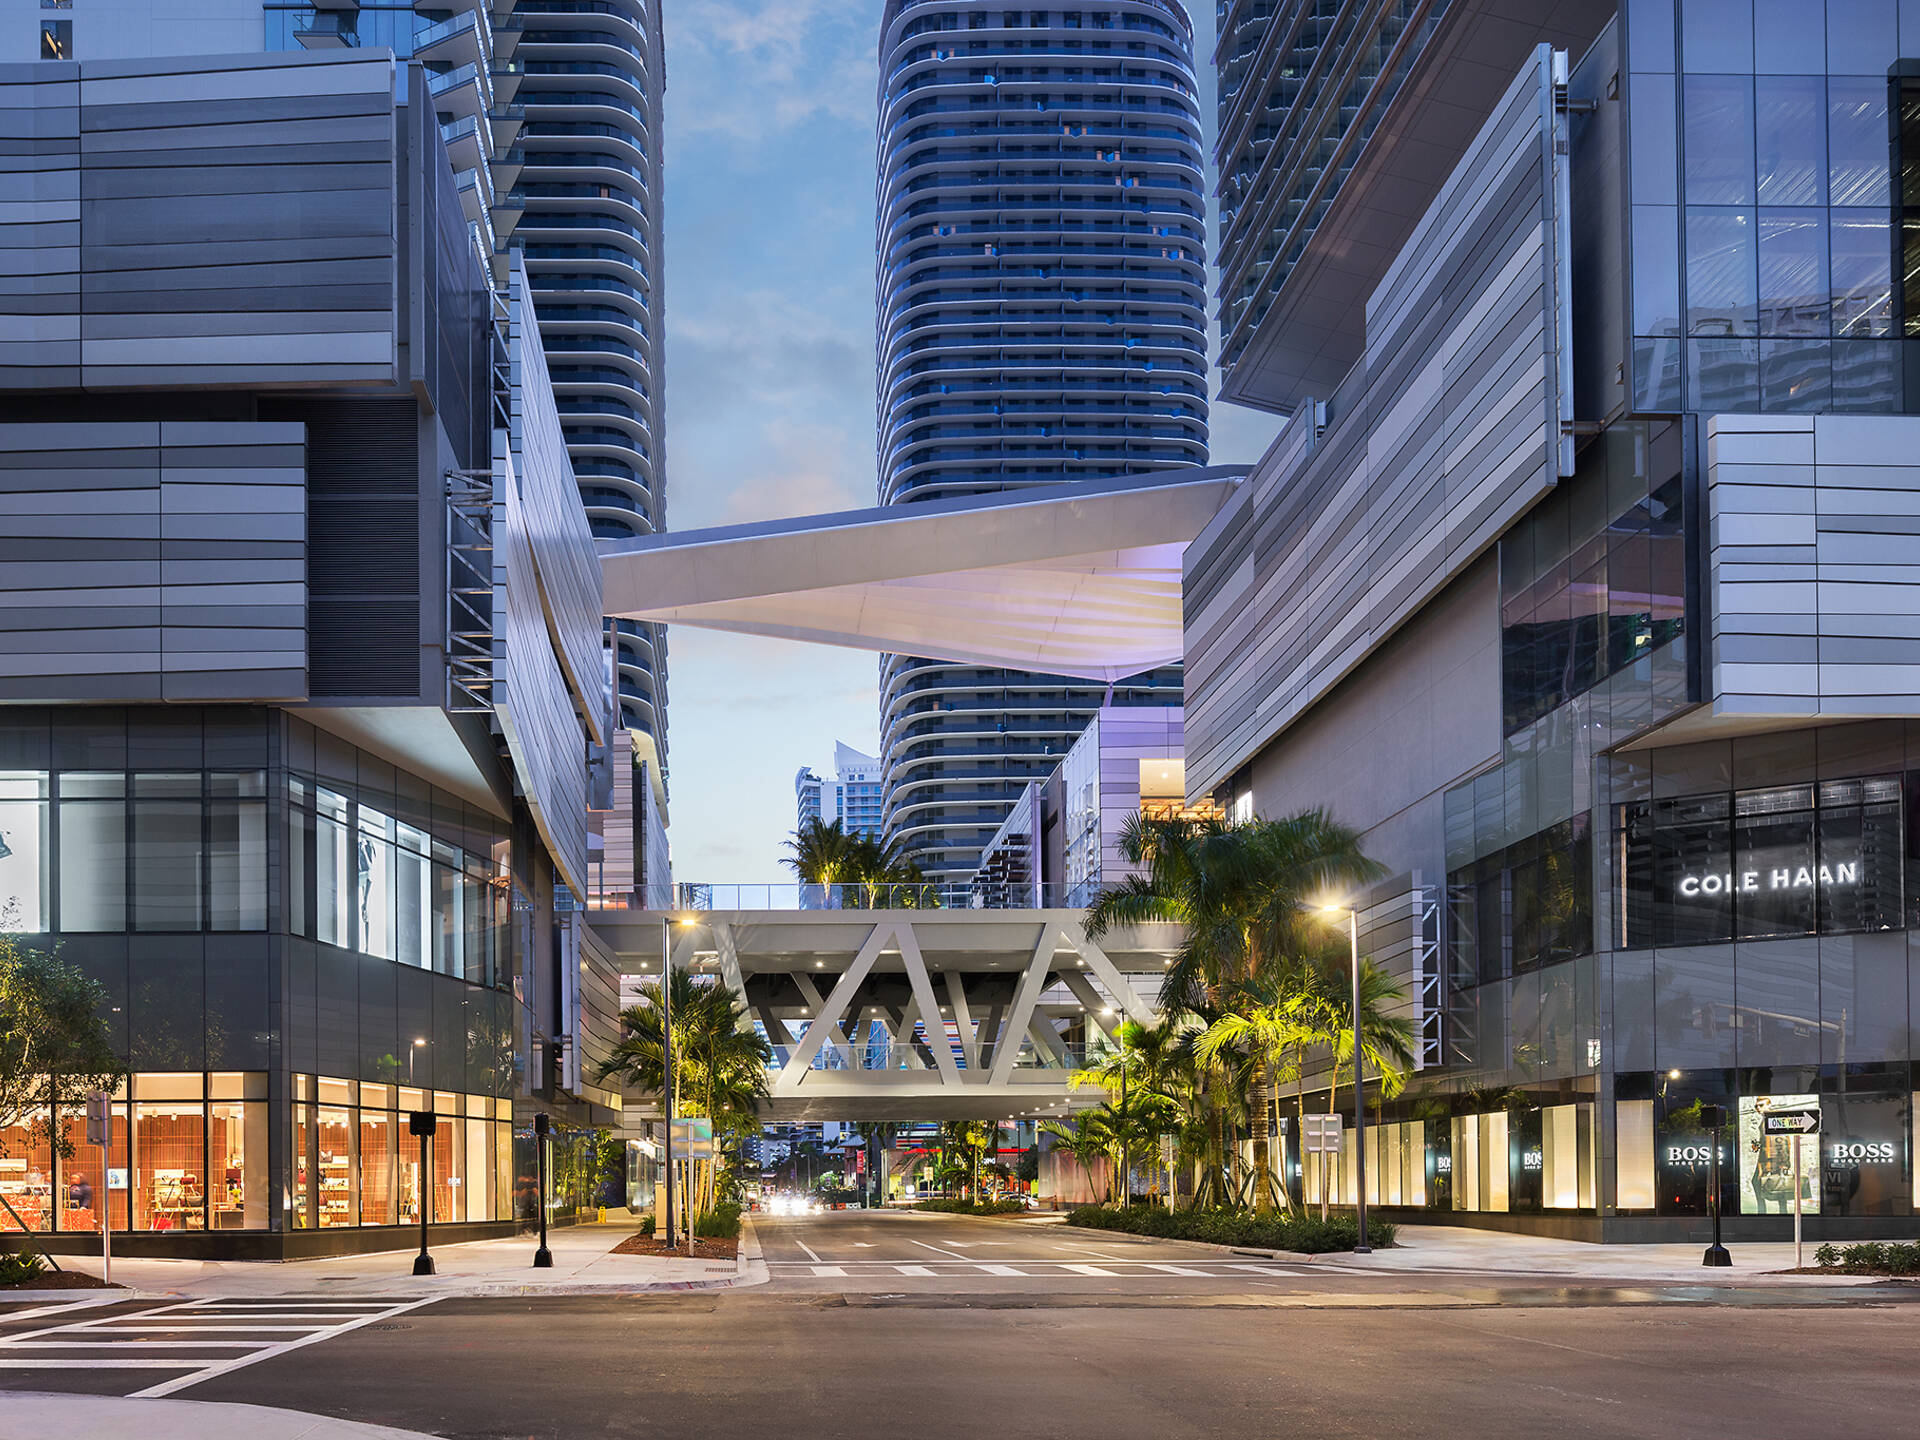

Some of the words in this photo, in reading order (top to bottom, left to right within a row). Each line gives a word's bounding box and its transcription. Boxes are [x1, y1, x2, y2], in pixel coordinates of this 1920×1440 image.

[1680, 871, 1759, 897] COLE
[1770, 861, 1857, 888] HAAN
[1771, 1118, 1786, 1128] ONE
[1788, 1117, 1803, 1126] WAY
[1832, 1143, 1894, 1158] BOSS
